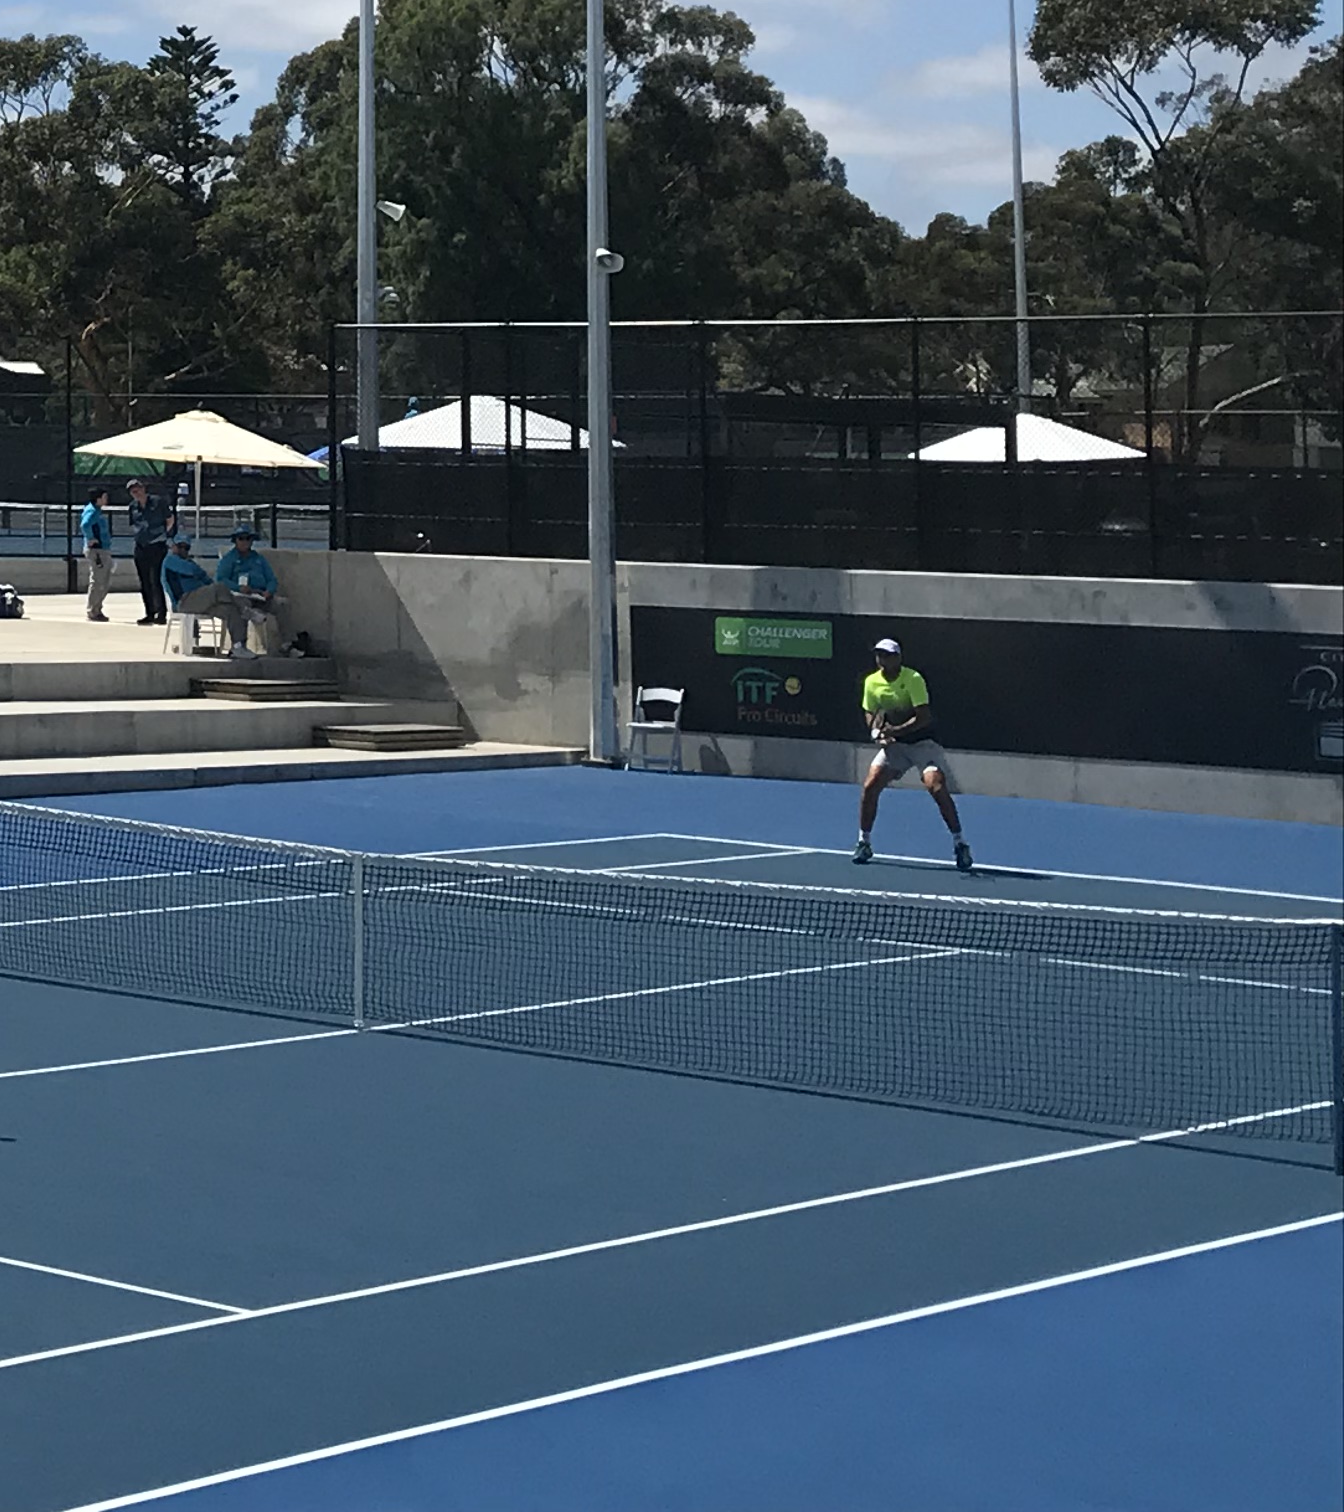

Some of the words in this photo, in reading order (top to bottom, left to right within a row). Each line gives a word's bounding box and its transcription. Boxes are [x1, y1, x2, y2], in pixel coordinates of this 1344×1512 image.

[747, 626, 828, 640] CHALLENGER
[748, 637, 781, 649] TOUR
[736, 680, 780, 704] ITF
[737, 706, 761, 722] Pro
[766, 708, 818, 725] Circuits
